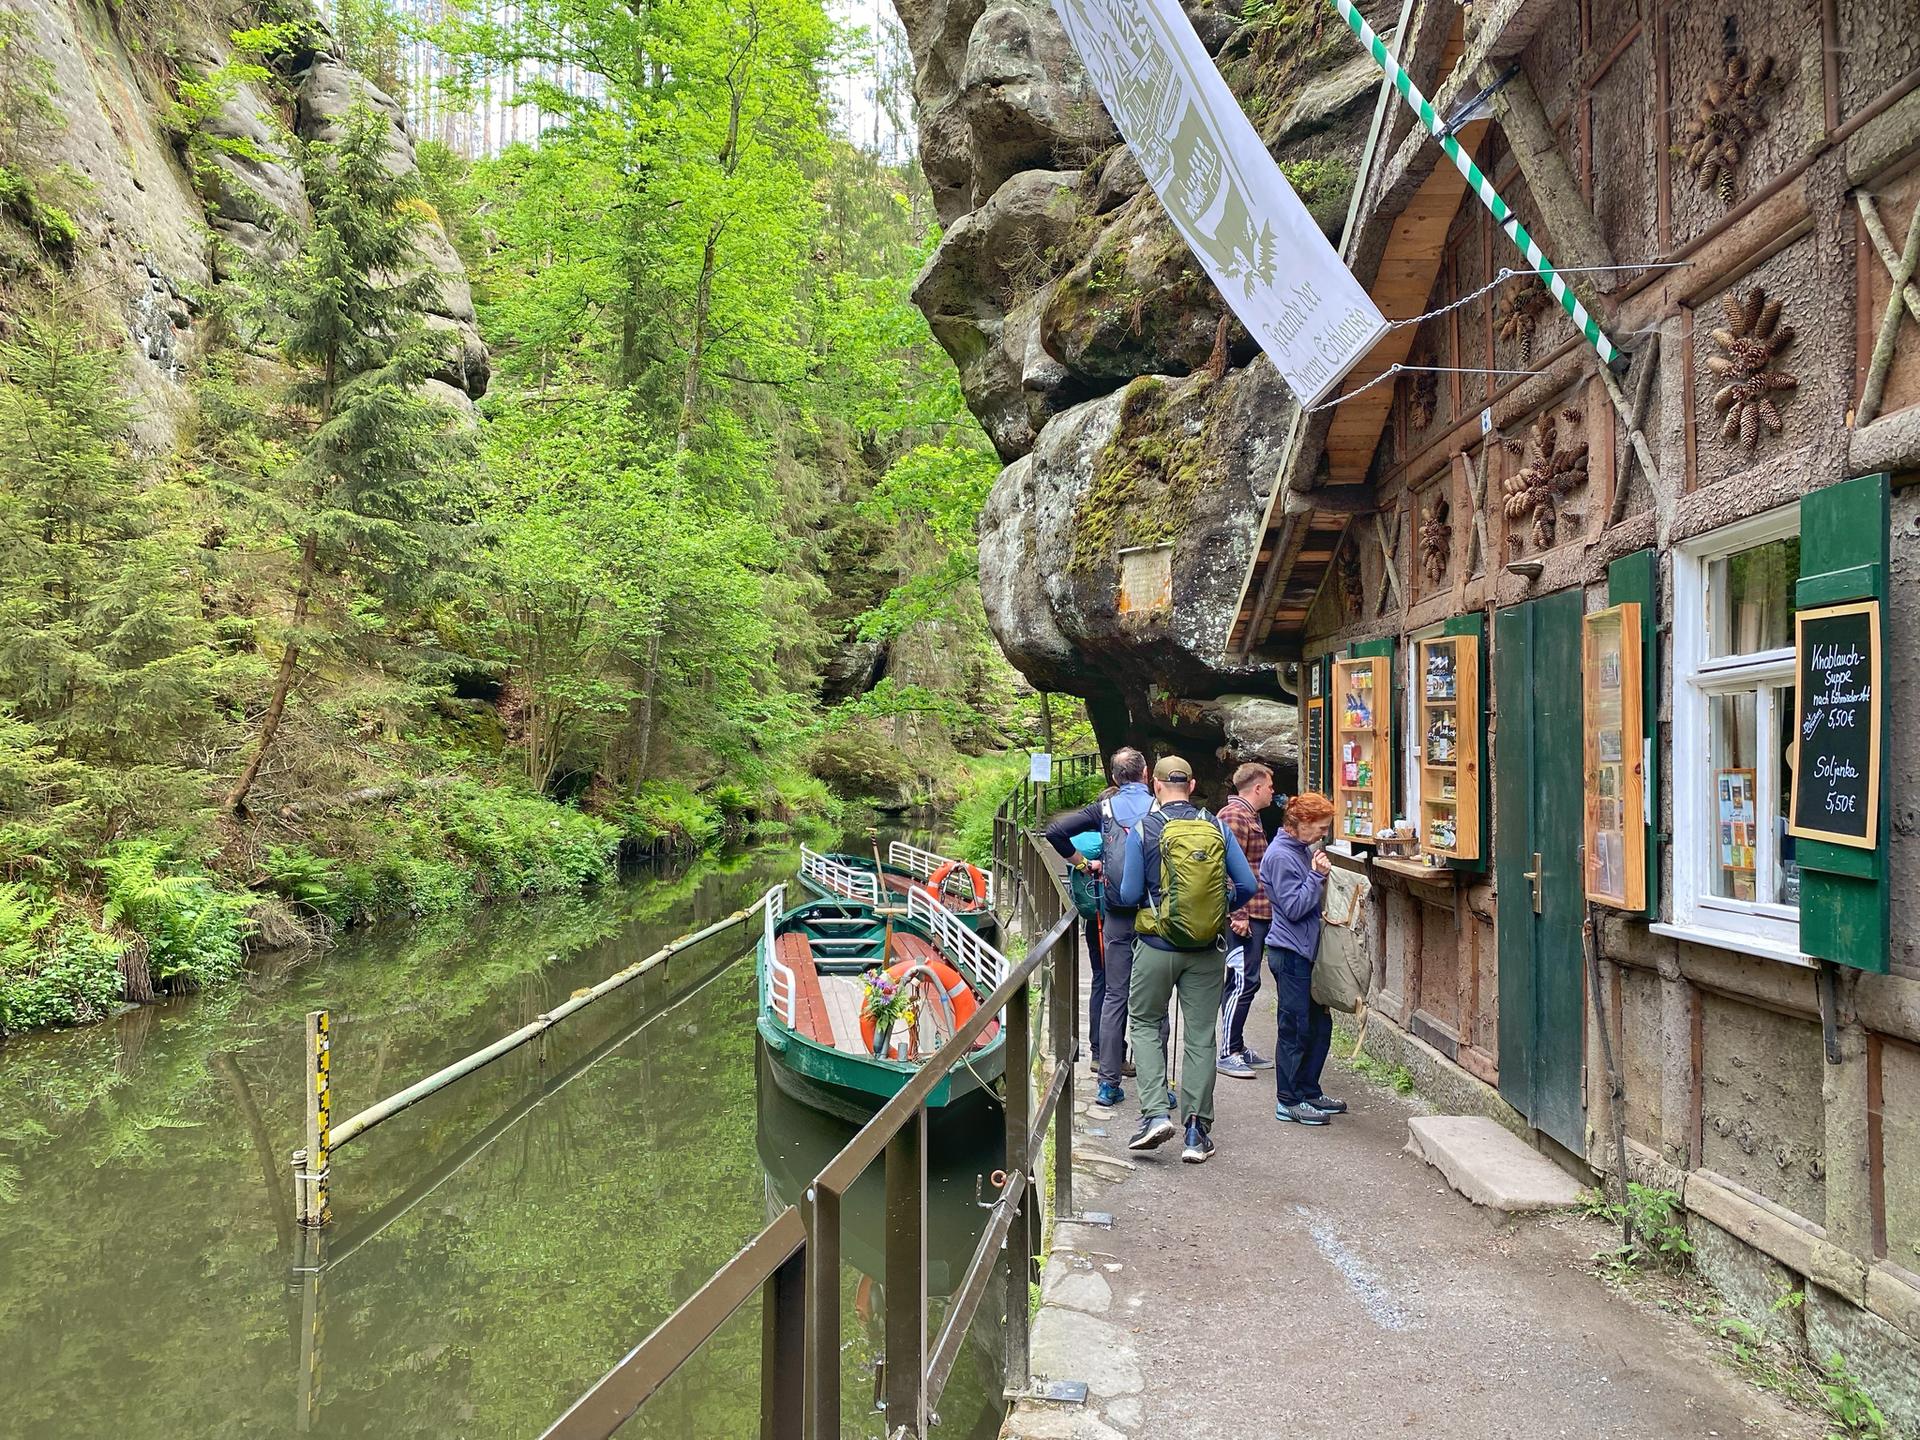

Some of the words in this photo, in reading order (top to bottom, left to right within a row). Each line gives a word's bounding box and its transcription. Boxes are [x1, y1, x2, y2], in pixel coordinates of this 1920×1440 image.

[1262, 299, 1308, 358] Freunde
[1290, 281, 1322, 312] der
[1284, 356, 1330, 399] Oberen
[1313, 307, 1374, 365] Schleuse
[1811, 643, 1866, 671] Knoblauch-
[1828, 708, 1856, 729] 5,50€
[1814, 755, 1860, 786] Soljanka
[1825, 791, 1856, 814] 5,50€
